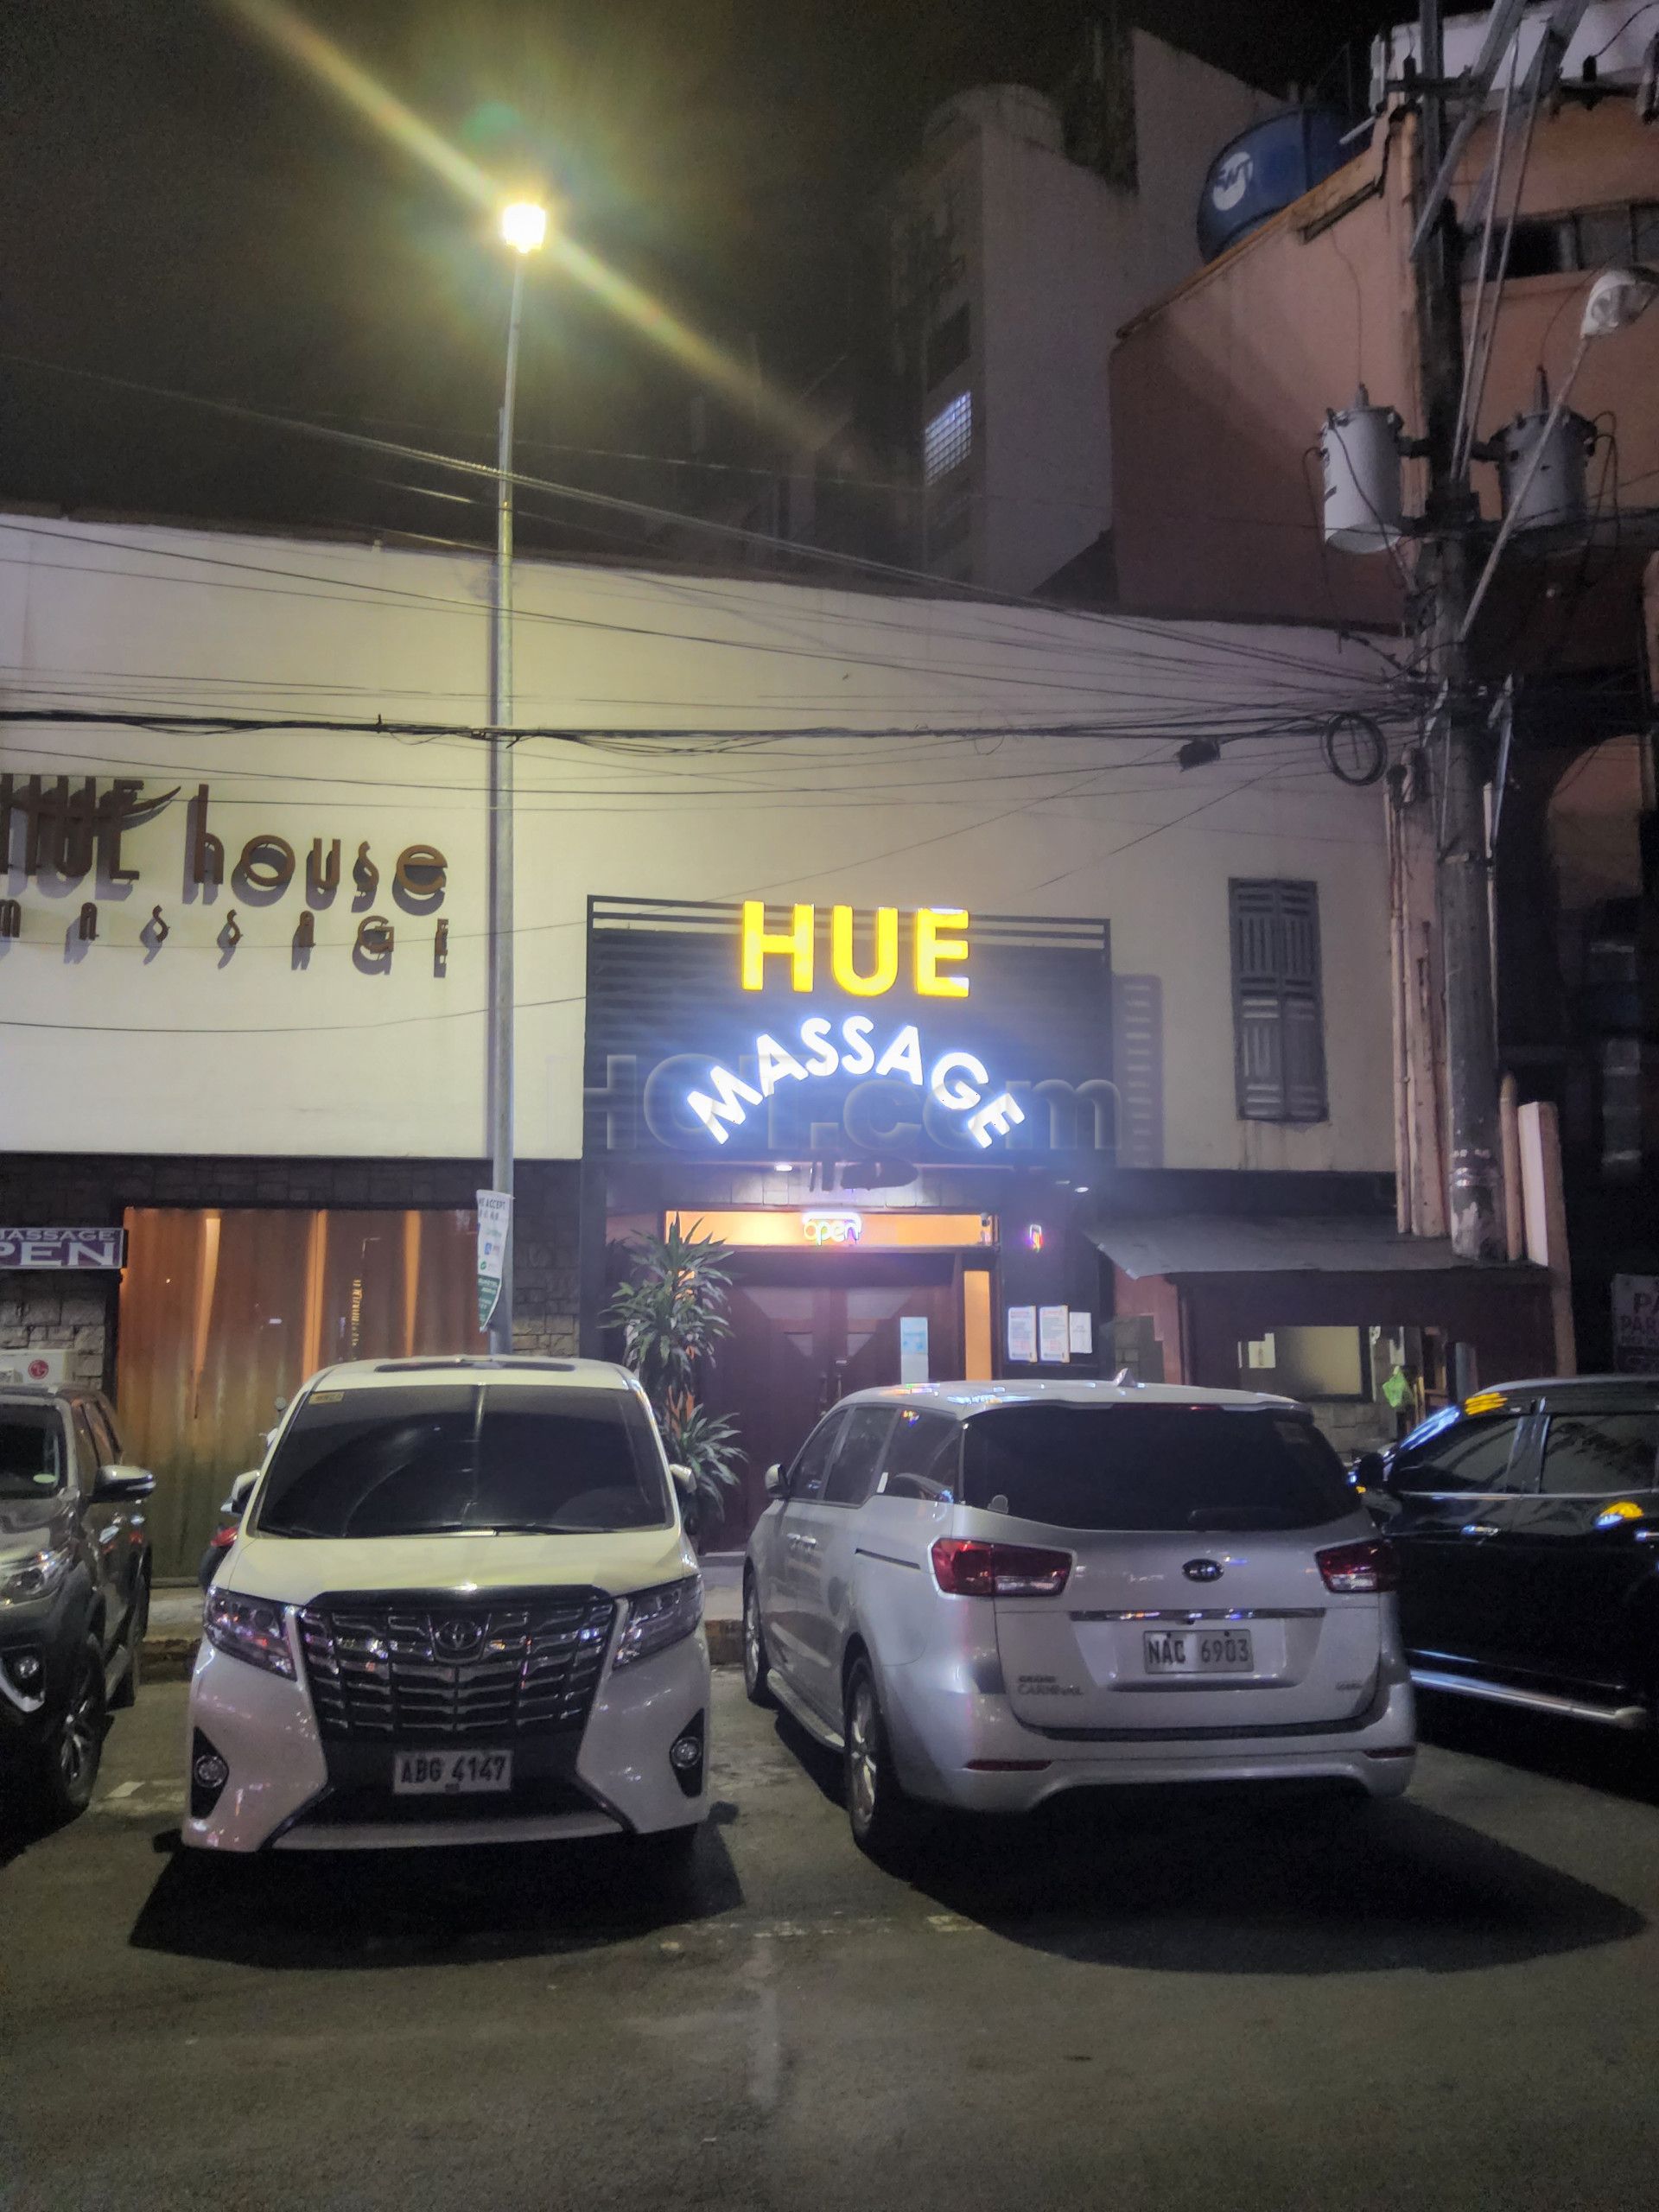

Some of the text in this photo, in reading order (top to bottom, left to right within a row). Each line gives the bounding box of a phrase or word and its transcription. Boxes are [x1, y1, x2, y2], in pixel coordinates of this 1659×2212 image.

[194, 784, 448, 895] house
[741, 900, 969, 997] HUE
[687, 1015, 1025, 1148] MASSAGE
[0, 1230, 115, 1242] ASSAGE
[1147, 1638, 1249, 1664] NAC 6903
[451, 1755, 505, 1782] 4147
